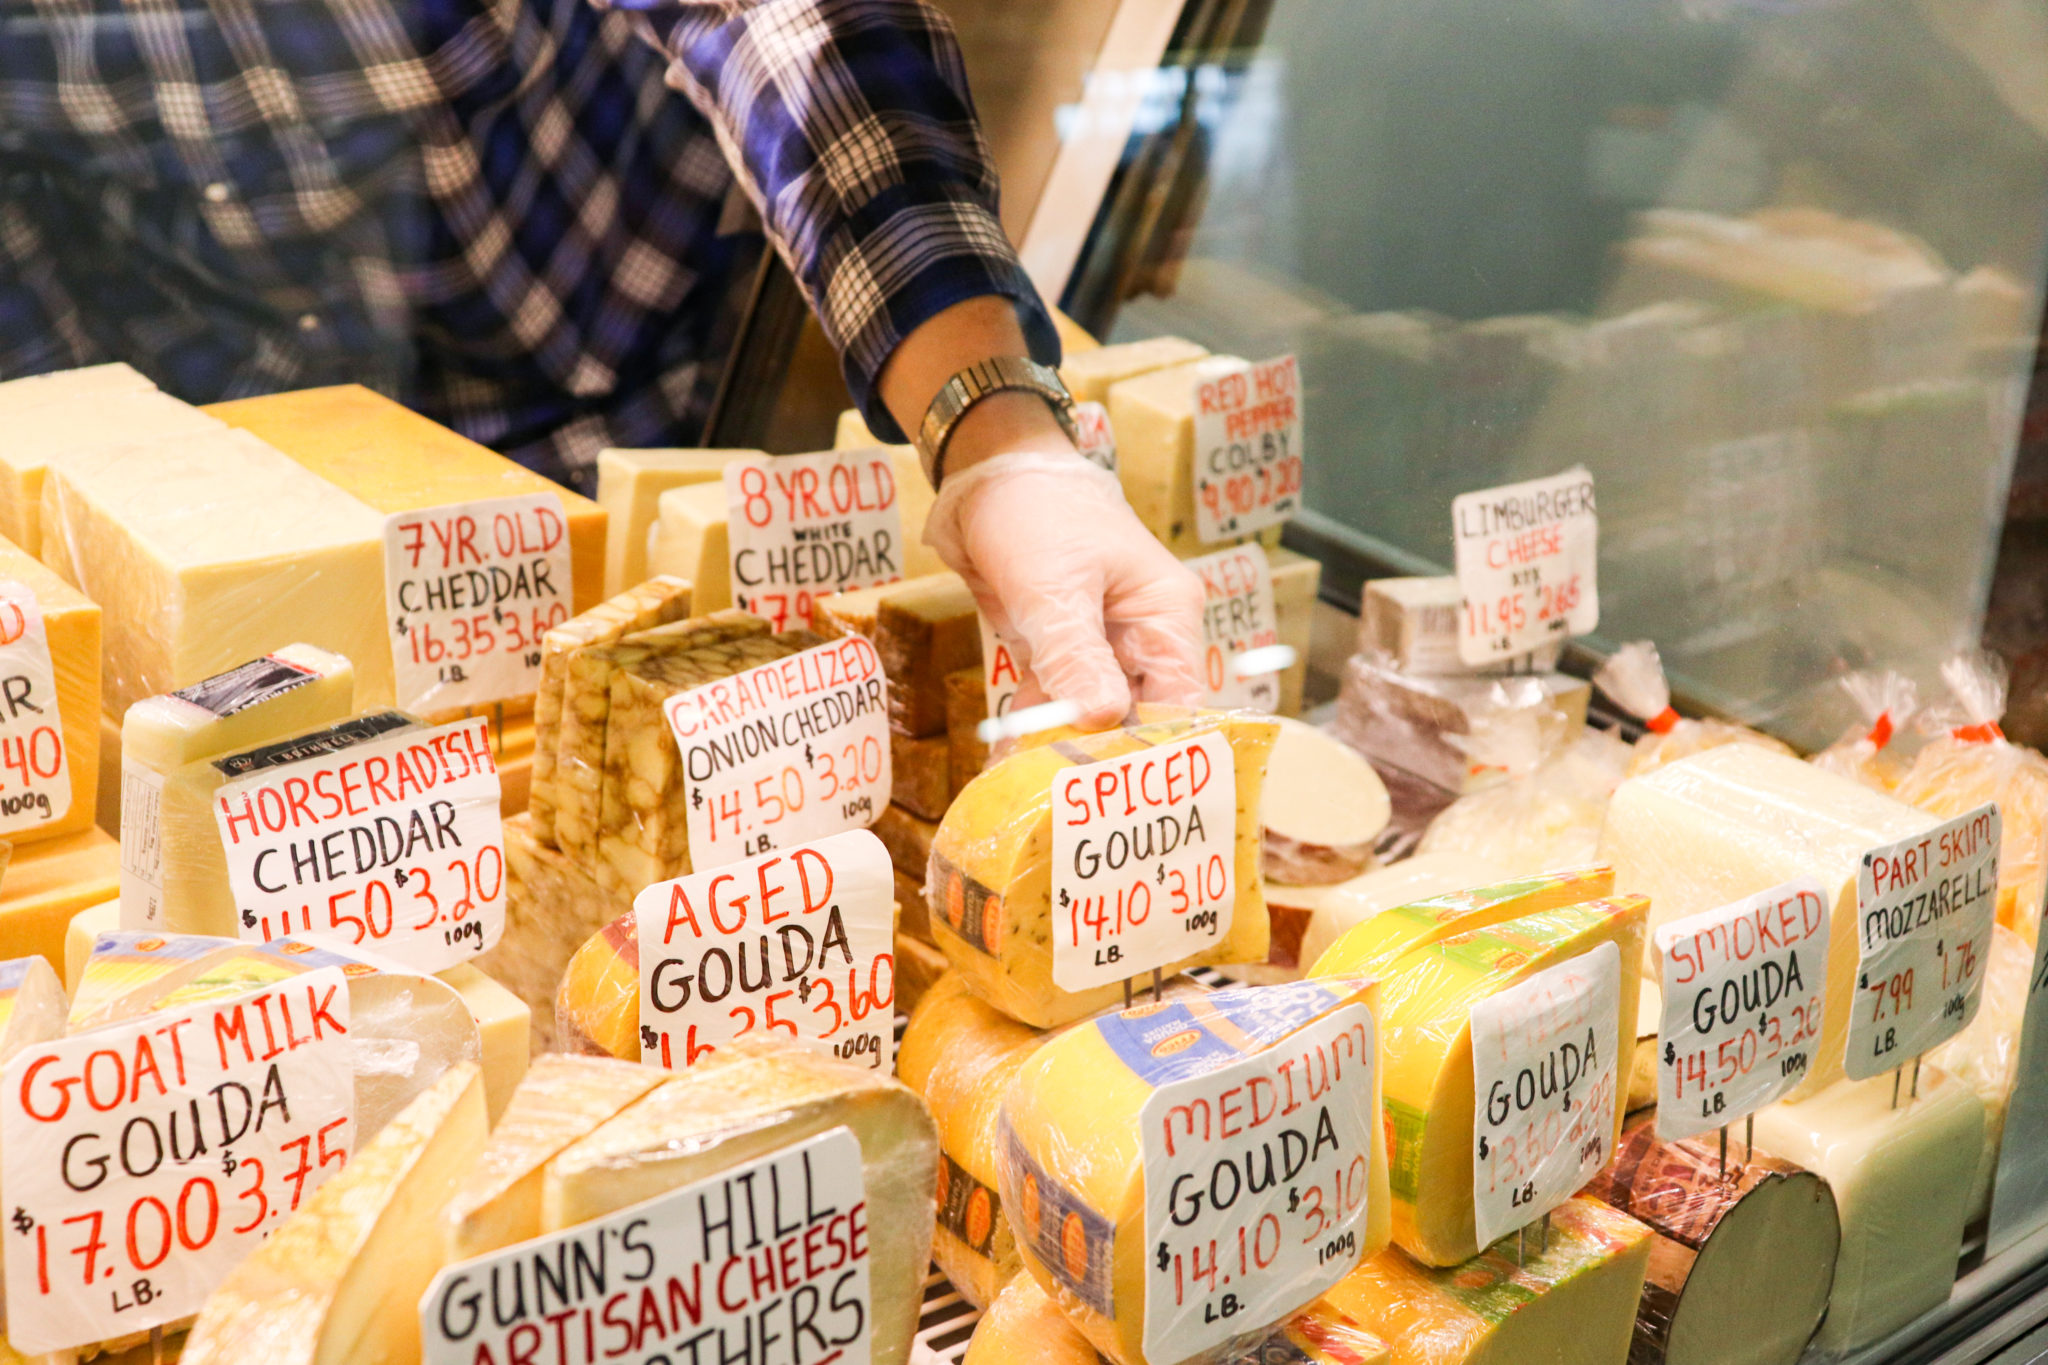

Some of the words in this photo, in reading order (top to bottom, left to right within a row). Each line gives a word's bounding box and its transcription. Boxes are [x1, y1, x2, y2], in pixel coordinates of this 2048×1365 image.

[1198, 373, 1247, 416] RED
[1209, 427, 1289, 475] COLBY
[494, 507, 562, 558] OLD
[792, 521, 853, 541] WHITE
[1461, 482, 1597, 538] LIMBURGER
[1487, 523, 1564, 569] CHEESE
[398, 558, 557, 612] CHEDDAR
[735, 529, 896, 586] CHEDDAR
[1199, 555, 1259, 599] KED
[671, 637, 877, 737] CARAMELIZED
[688, 715, 779, 782] ONION
[782, 678, 886, 746] CHEDDAR
[220, 724, 496, 844] HORSERADISH
[1065, 744, 1211, 826] SPICED
[253, 800, 462, 893] CHEDDAR
[1074, 804, 1206, 880] GOUDA
[444, 921, 483, 950] 100g
[663, 848, 834, 944] AGED
[1186, 910, 1218, 936] 100g
[1670, 890, 1822, 984] SMOKED
[650, 904, 854, 1013] GOUDA
[1692, 950, 1804, 1034] GOUDA
[19, 1017, 192, 1122] GOAT
[213, 983, 347, 1072] MILK
[1163, 1023, 1367, 1157] MEDIUM
[1487, 1027, 1597, 1127] GOUDA
[61, 1063, 291, 1192] GOUDA
[1169, 1106, 1339, 1227] GOUDA
[698, 1150, 837, 1263] HILL
[111, 1277, 163, 1313] LB.
[715, 1201, 870, 1315] CHEESE
[1204, 1294, 1246, 1324] LB.
[1318, 1231, 1356, 1265] 100g
